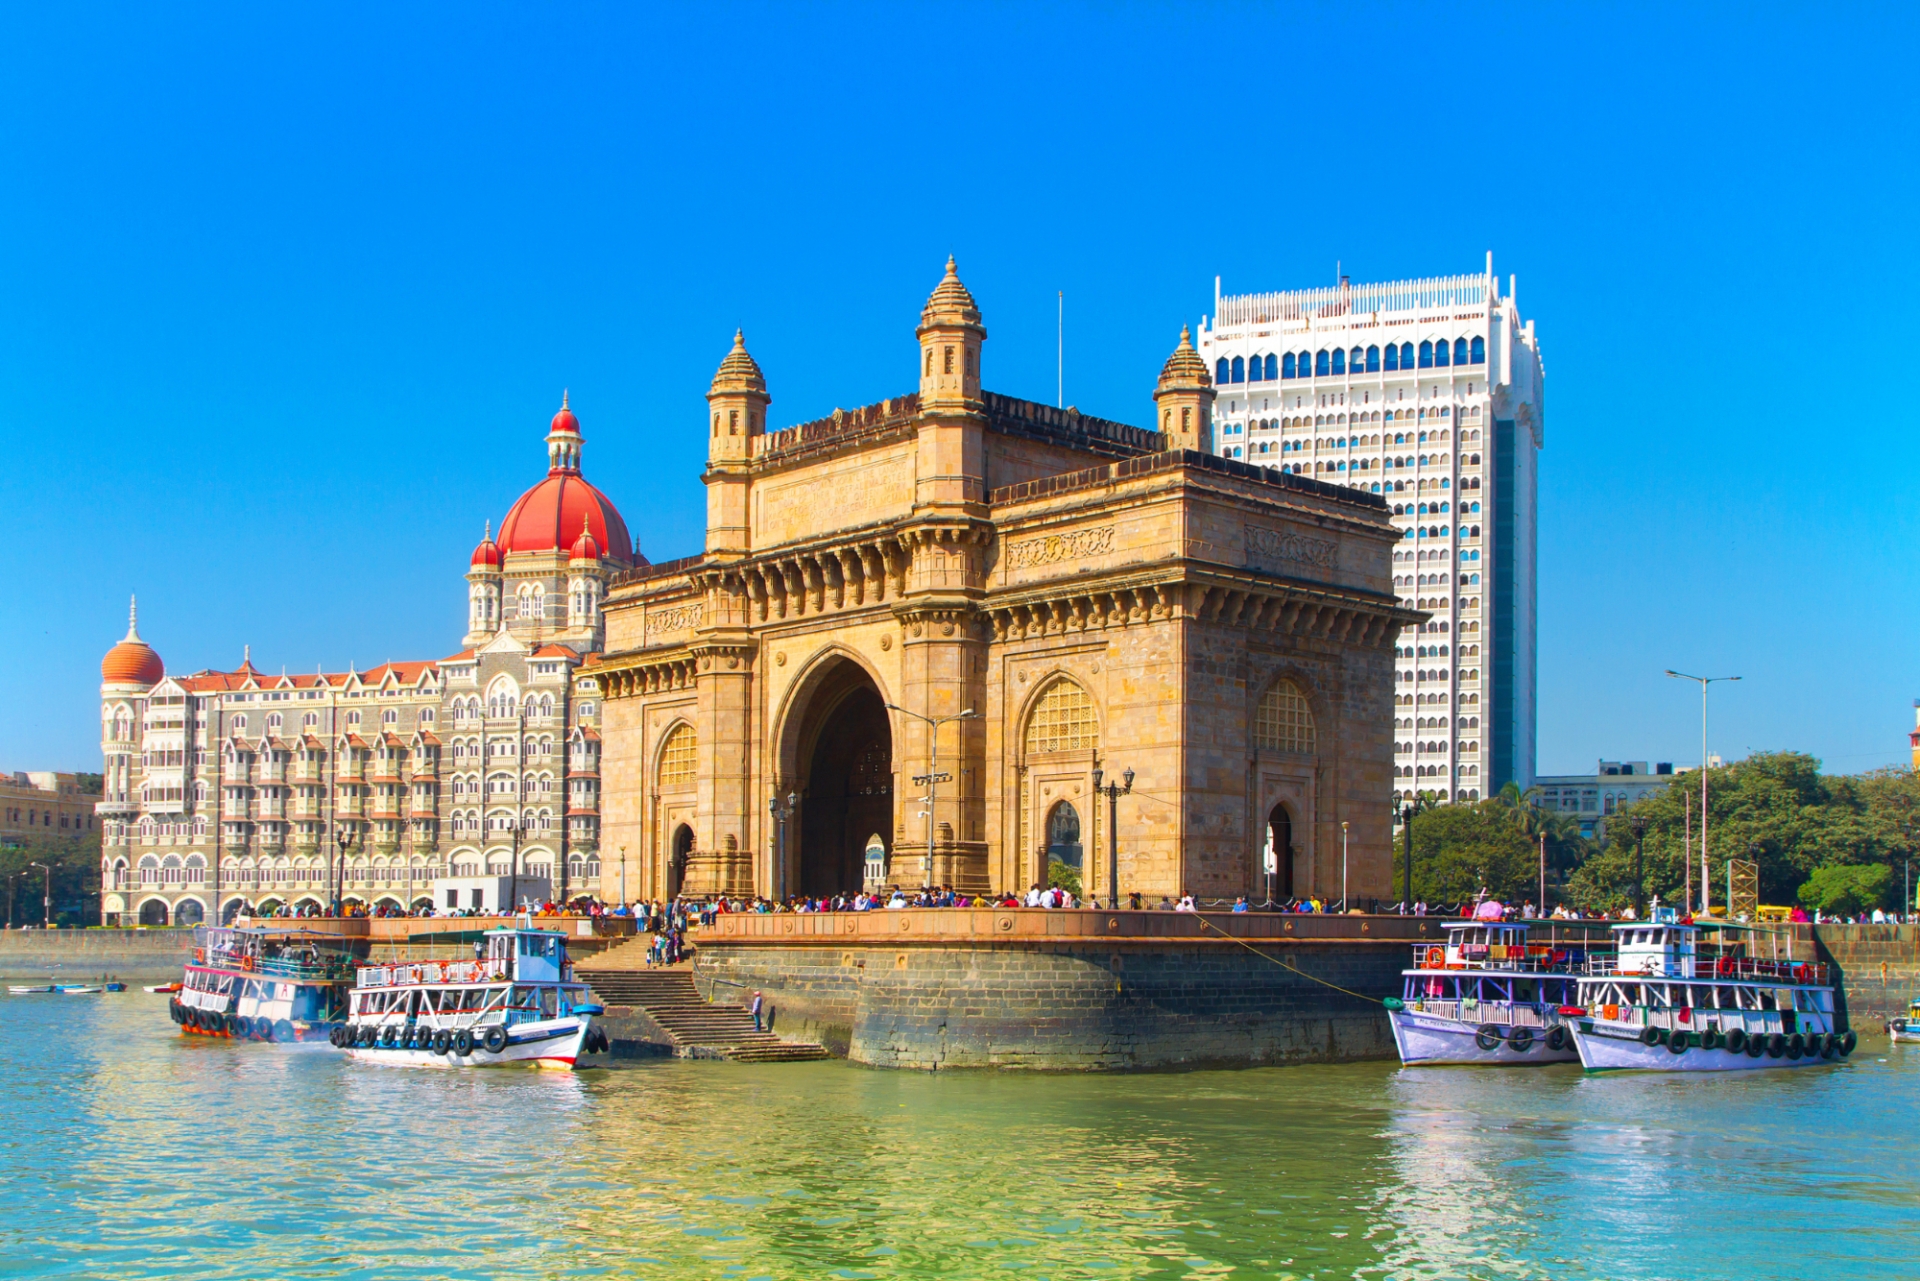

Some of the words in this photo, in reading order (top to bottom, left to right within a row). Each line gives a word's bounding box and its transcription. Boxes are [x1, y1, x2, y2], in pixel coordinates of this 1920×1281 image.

[799, 486, 807, 495] TO
[810, 473, 861, 492] COMMEMORATE
[863, 469, 875, 480] THE
[879, 461, 907, 476] LANDING
[834, 482, 864, 496] IMPERIAL
[869, 471, 907, 487] MAJESTIES
[769, 520, 779, 530] ON
[782, 516, 794, 526] THE
[828, 506, 838, 517] OF
[841, 498, 876, 514] DECEMBER
[788, 502, 817, 517] GEORGE
[834, 495, 848, 505] AND
[854, 488, 879, 502] QUEEN
[884, 482, 907, 493] MARY
[281, 983, 288, 998] A
